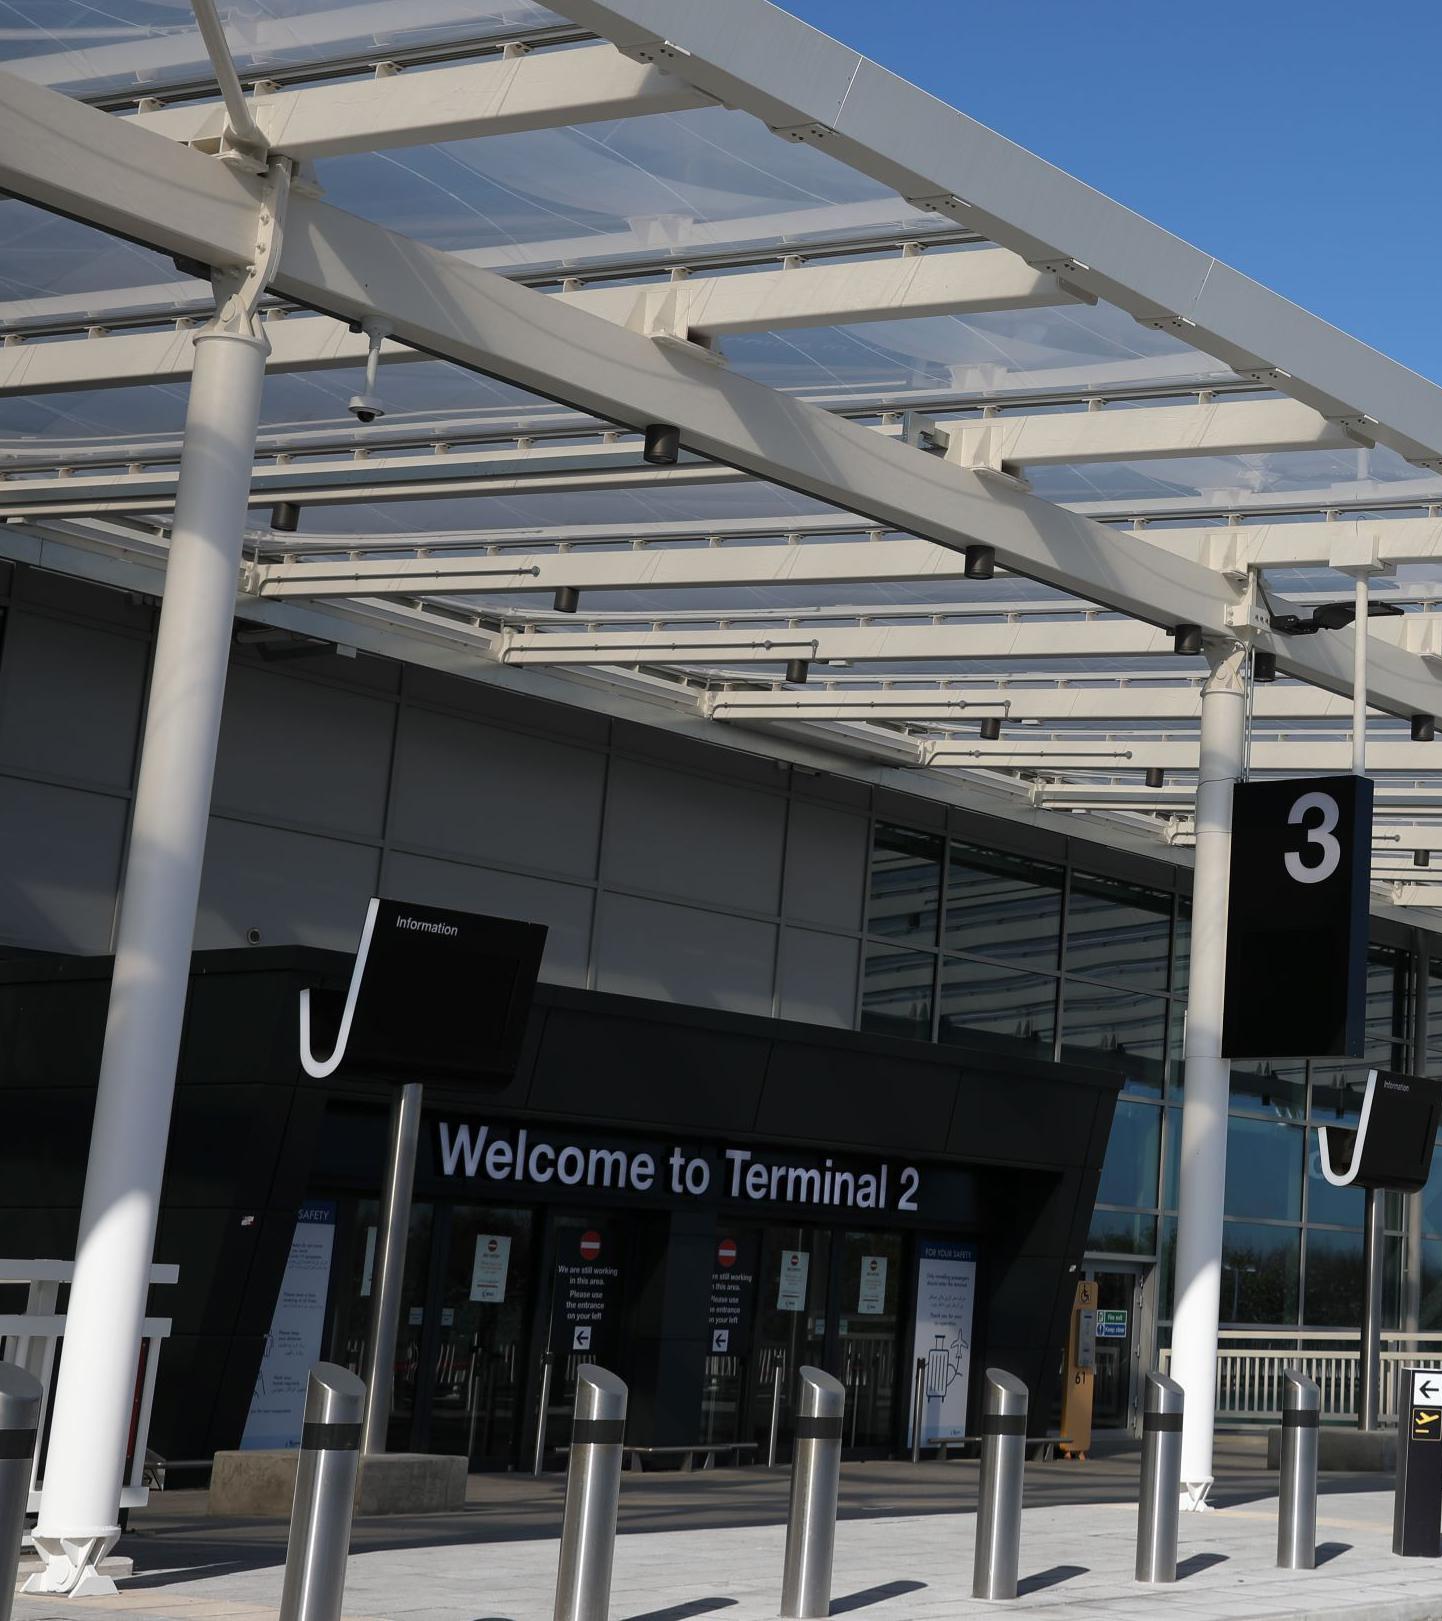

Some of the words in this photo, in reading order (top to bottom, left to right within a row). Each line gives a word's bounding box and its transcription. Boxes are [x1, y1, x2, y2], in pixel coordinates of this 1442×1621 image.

[1284, 792, 1341, 884] 3
[396, 915, 458, 936] Information
[1384, 1080, 1409, 1092] Information
[439, 1122, 655, 1190] Welcome
[669, 1147, 710, 1195] to
[725, 1149, 888, 1209] Terminal
[897, 1167, 920, 1211] 2
[298, 1209, 330, 1221] SAFETY
[558, 1265, 568, 1273] We
[581, 1266, 593, 1274] still
[594, 1267, 618, 1277] working
[577, 1276, 588, 1285] this
[719, 1272, 730, 1280] still
[730, 1273, 752, 1283] working
[569, 1290, 590, 1298] Please
[566, 1301, 576, 1309] the
[716, 1305, 741, 1313] entrance
[591, 1312, 602, 1320] left
[729, 1316, 738, 1324] left
